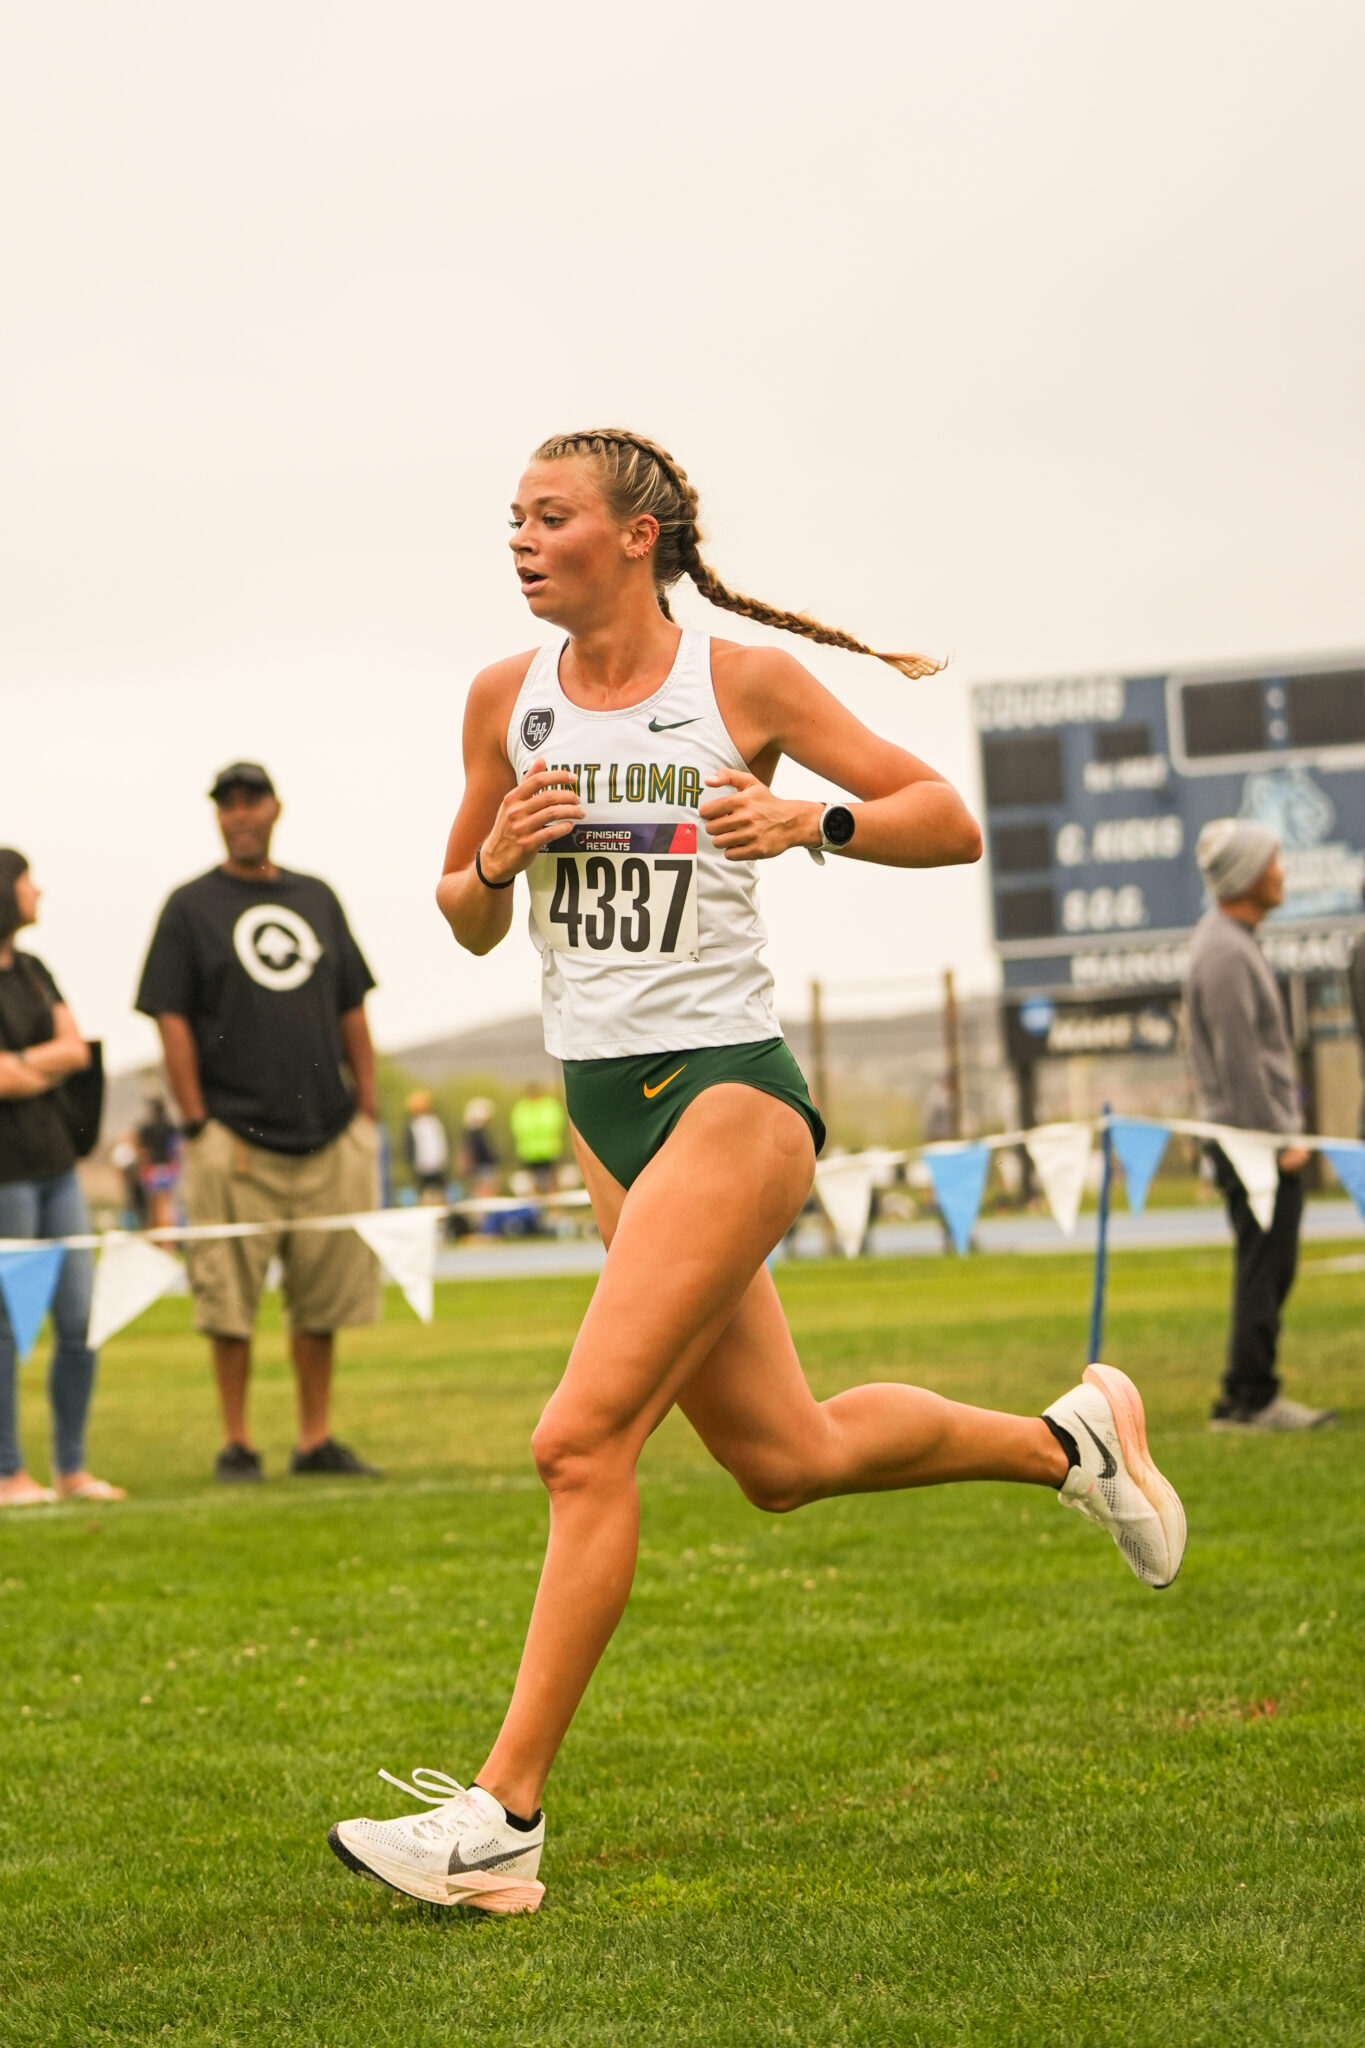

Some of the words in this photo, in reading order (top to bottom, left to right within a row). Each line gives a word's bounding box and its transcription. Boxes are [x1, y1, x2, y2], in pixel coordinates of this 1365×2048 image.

[608, 763, 704, 809] LOMA
[586, 830, 632, 840] FINISHED
[586, 842, 631, 852] RESULTS
[550, 856, 693, 953] 4337
